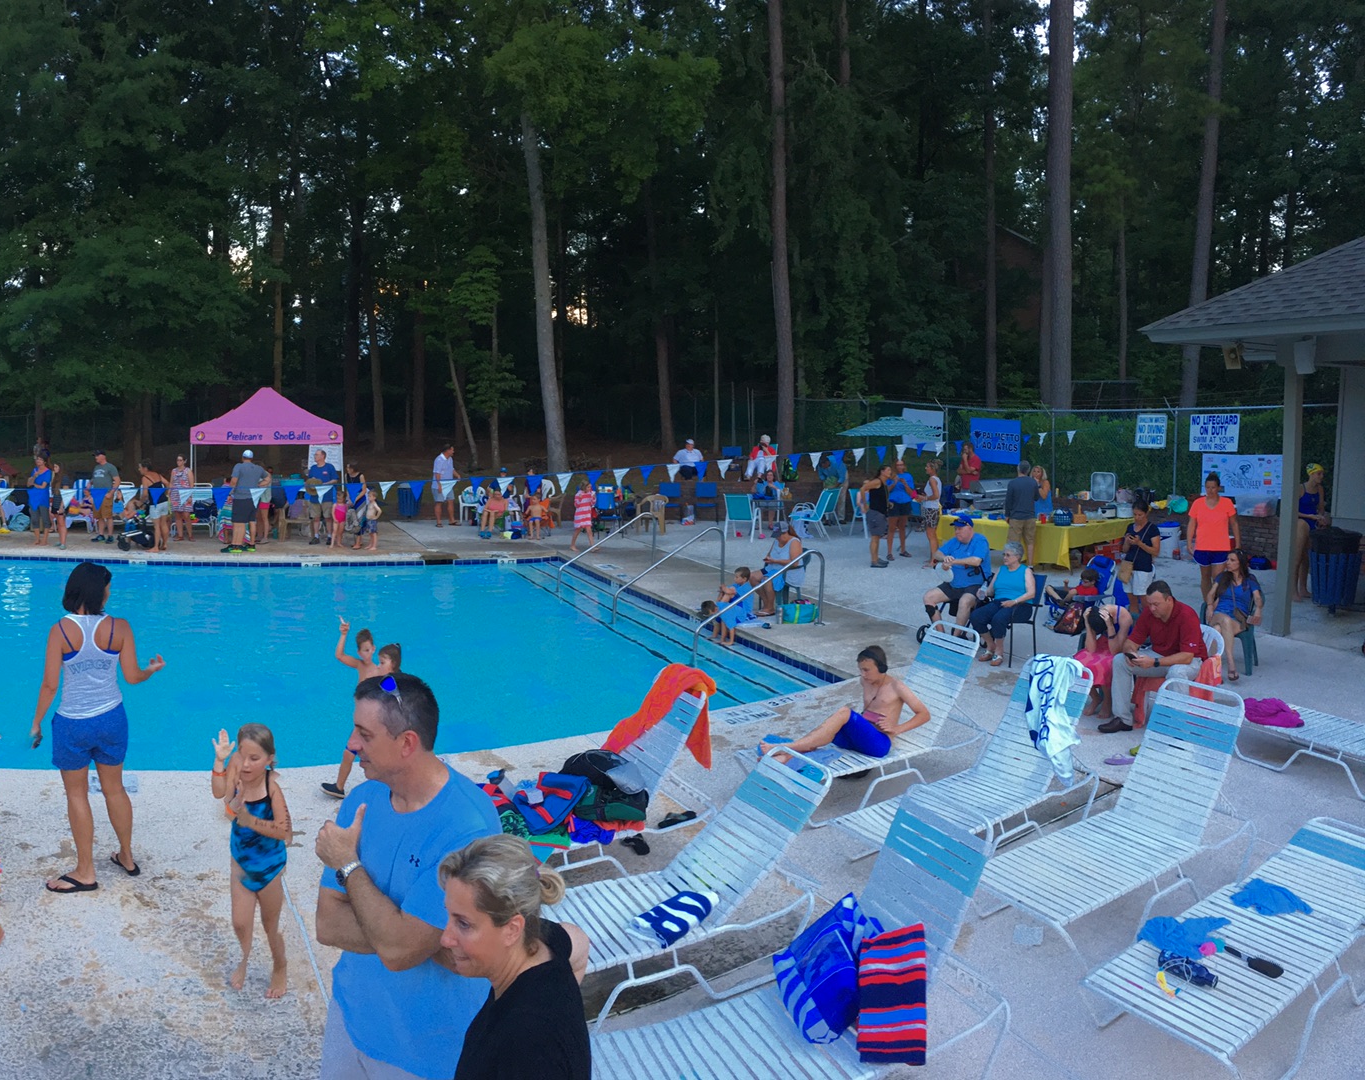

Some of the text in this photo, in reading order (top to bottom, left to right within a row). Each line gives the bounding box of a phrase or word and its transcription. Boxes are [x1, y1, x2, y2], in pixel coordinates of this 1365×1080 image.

[1192, 415, 1238, 425] NO LIFEGUARD
[1138, 425, 1164, 434] NO DIVING
[1199, 426, 1228, 435] ON DUTY
[1138, 435, 1163, 445] ALLOWED
